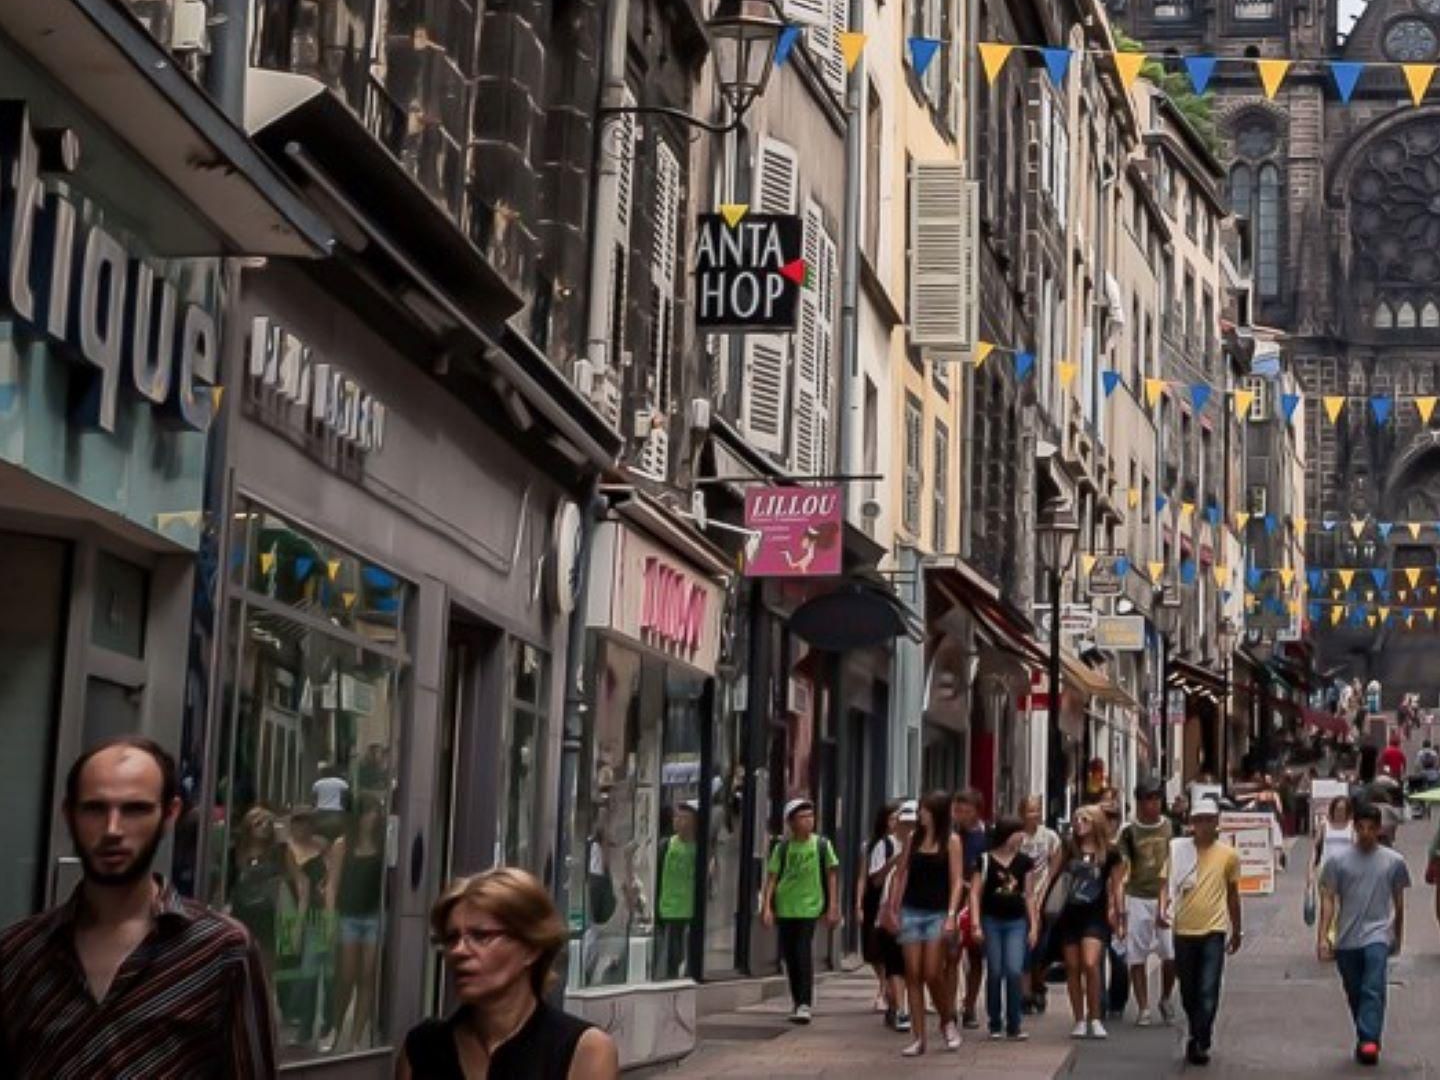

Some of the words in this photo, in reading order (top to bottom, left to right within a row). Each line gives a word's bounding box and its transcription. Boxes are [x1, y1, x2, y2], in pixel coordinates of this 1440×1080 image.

[695, 221, 785, 268] ANTA
[700, 271, 785, 318] HOP
[752, 494, 837, 518] LILLOU
